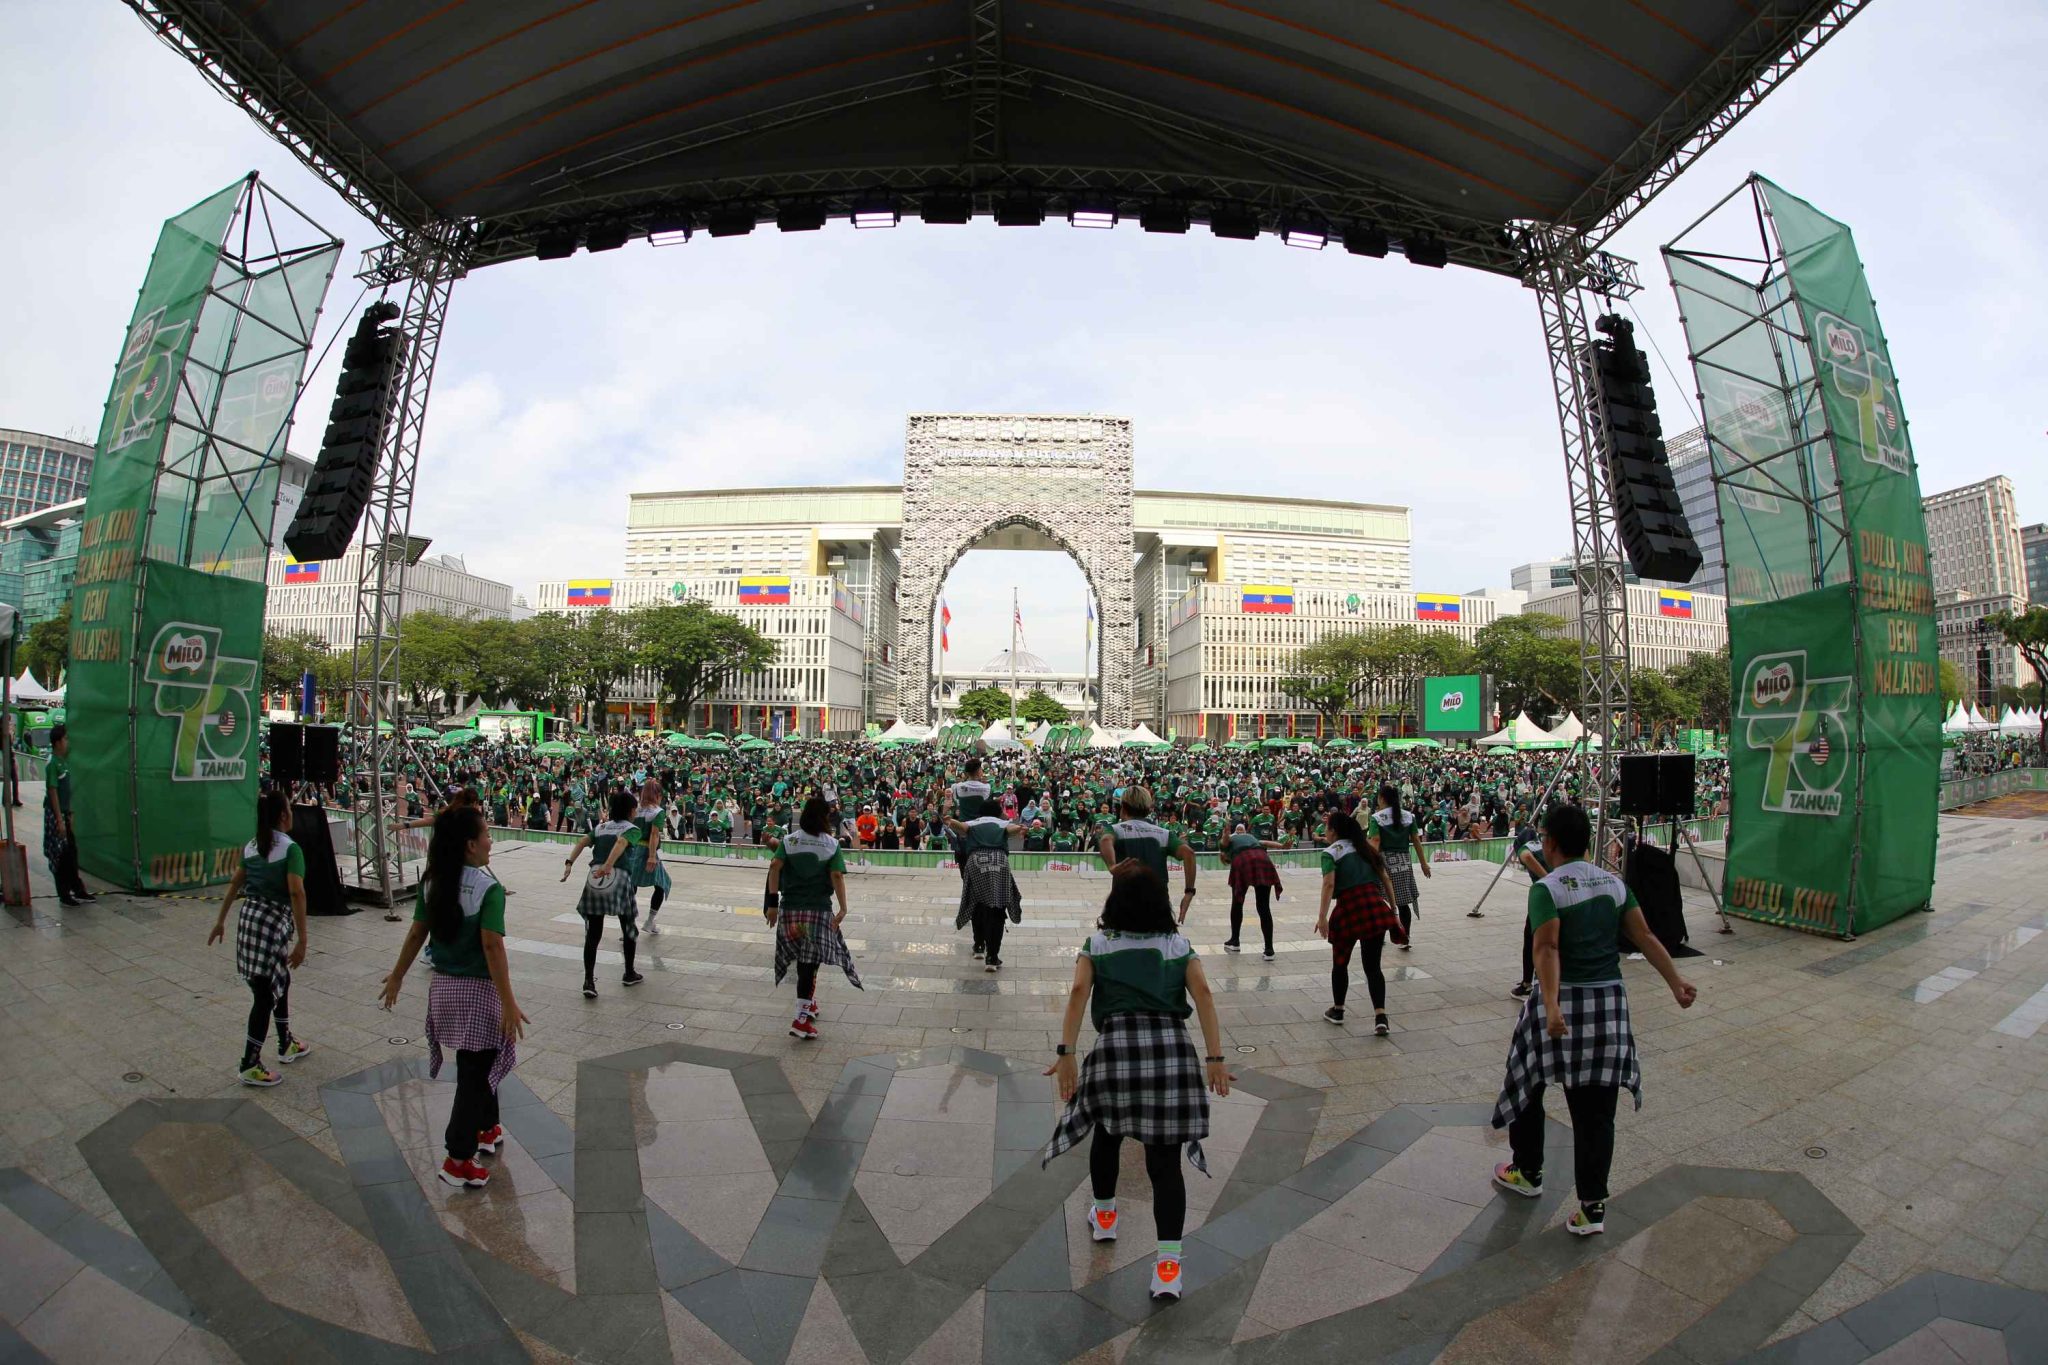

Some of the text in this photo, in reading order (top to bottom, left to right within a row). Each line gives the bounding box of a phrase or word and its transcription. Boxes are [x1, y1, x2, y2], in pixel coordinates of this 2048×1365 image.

[1828, 331, 1855, 354] MILO
[1860, 529, 1901, 576] DULU,
[81, 588, 110, 623] DEMI
[1887, 618, 1918, 654] DEMI
[167, 645, 203, 664] MILO
[1756, 675, 1791, 698] MILO
[1873, 659, 1936, 695] MALAYSIA
[1443, 697, 1461, 707] MILO
[200, 761, 245, 777] TAHUN
[1789, 793, 1840, 811] TAHUN
[150, 850, 208, 887] DULU,
[1732, 875, 1785, 919] DULU,
